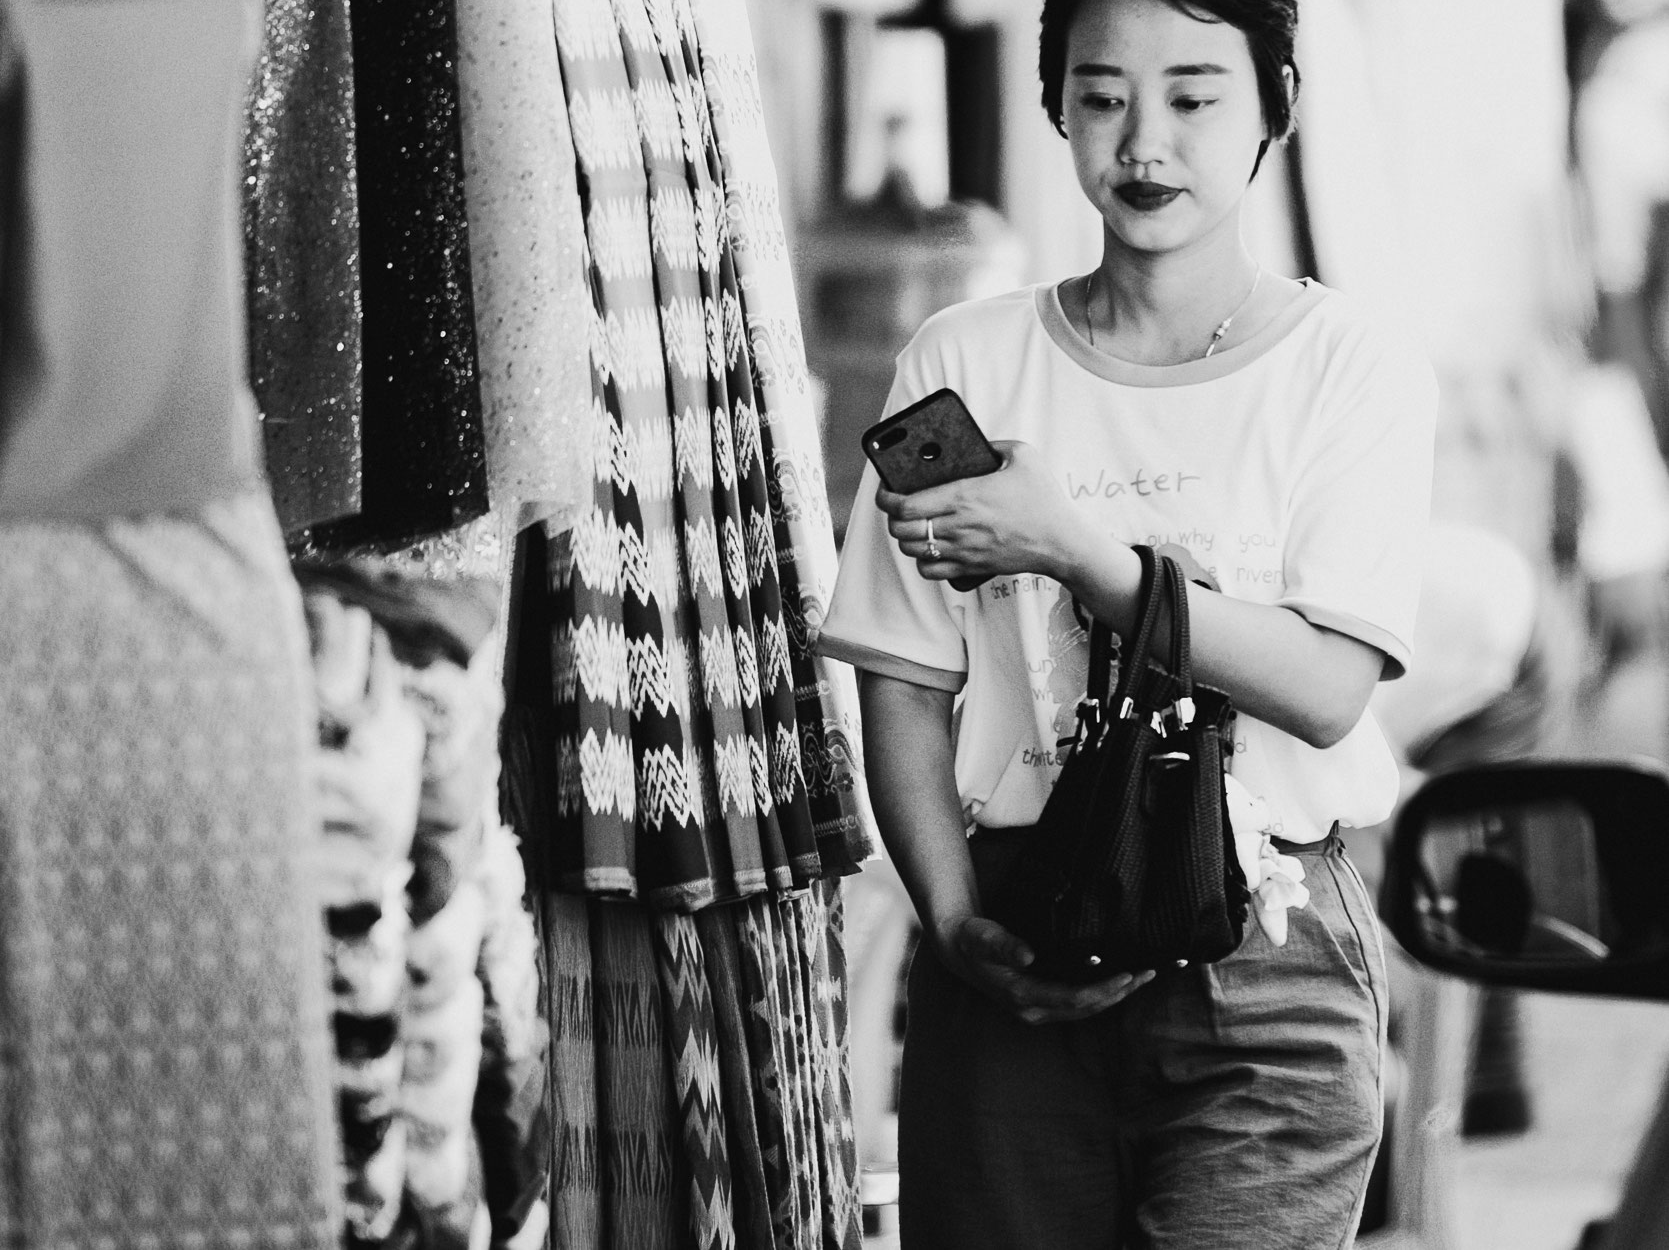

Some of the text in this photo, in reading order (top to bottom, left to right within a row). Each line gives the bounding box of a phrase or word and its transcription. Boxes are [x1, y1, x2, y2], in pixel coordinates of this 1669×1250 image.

[1066, 468, 1201, 500] Water
[1137, 527, 1276, 553] ou why you
